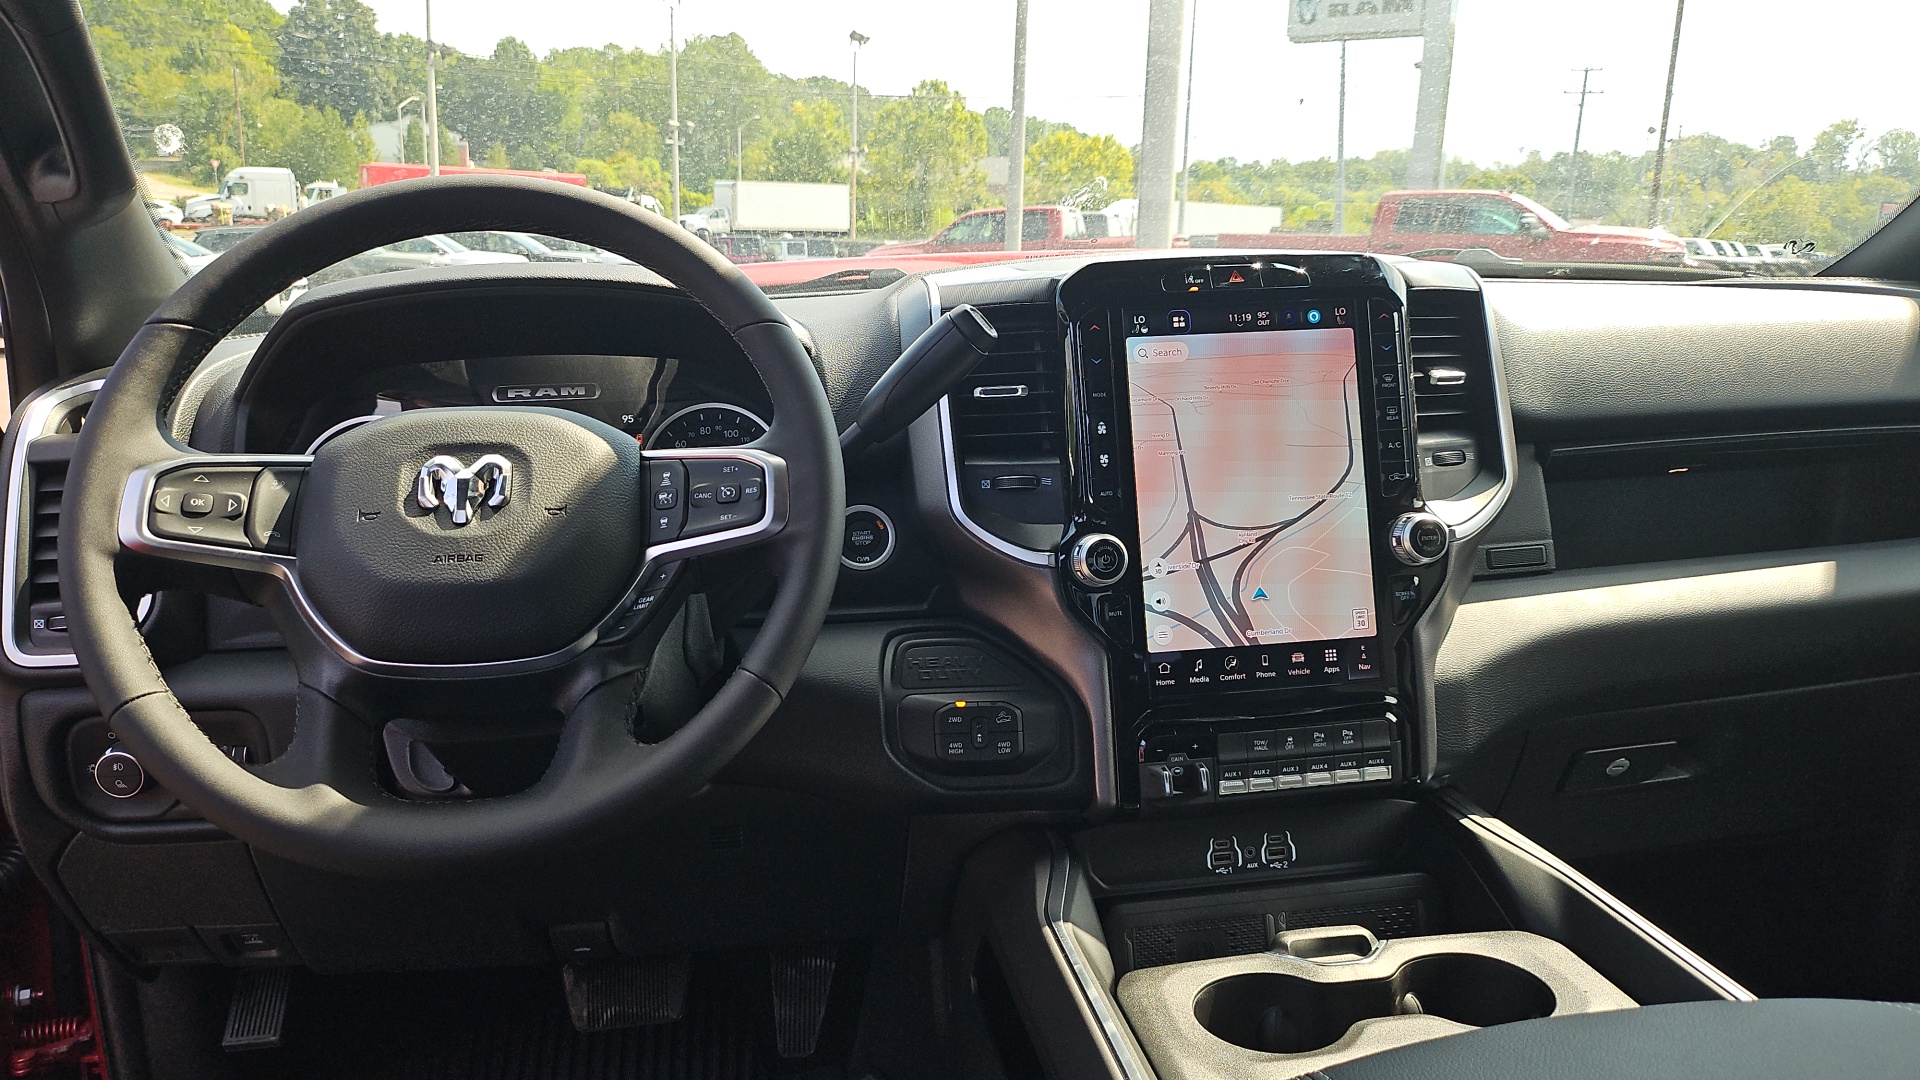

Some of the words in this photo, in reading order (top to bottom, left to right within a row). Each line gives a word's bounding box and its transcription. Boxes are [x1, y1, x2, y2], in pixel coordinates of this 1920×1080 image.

[1334, 307, 1347, 316] LO
[1133, 315, 1146, 324] LO
[1228, 313, 1252, 322] 11:19
[1152, 348, 1183, 357] Search
[507, 386, 587, 398] RAM
[621, 415, 635, 424] 95
[700, 427, 711, 435] 80
[723, 430, 739, 438] 100
[675, 440, 687, 448] 60
[190, 498, 205, 507] OK
[433, 554, 484, 564] AIRBAG
[638, 595, 655, 603] GEAR
[633, 602, 650, 610] LIMIT
[1356, 619, 1366, 627] 30
[907, 656, 984, 670] HEAVY
[918, 669, 980, 681] DUTY
[1219, 673, 1247, 681] Comfort
[1229, 866, 1233, 874] 1
